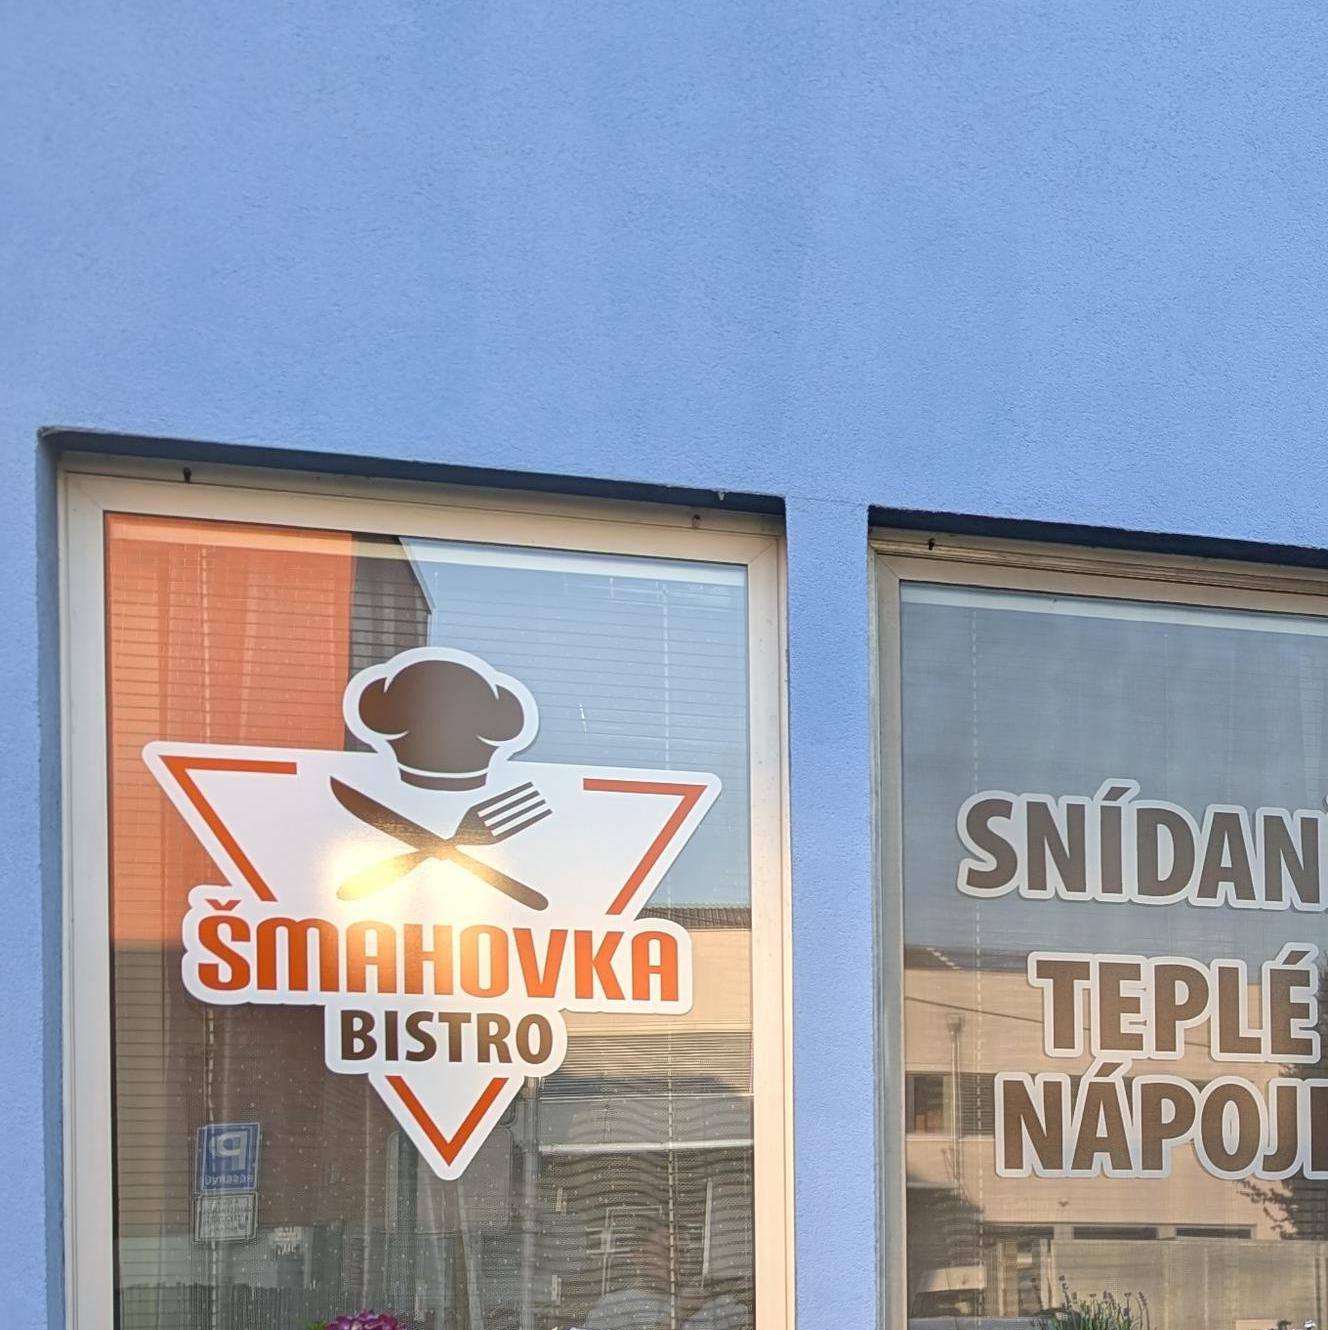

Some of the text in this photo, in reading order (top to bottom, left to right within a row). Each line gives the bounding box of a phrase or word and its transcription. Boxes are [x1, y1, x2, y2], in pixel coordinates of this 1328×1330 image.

[197, 898, 681, 1002] ŠMAHOVKA
[340, 1010, 553, 1065] BISTRO
[1036, 951, 1313, 1056] TEPLÉ
